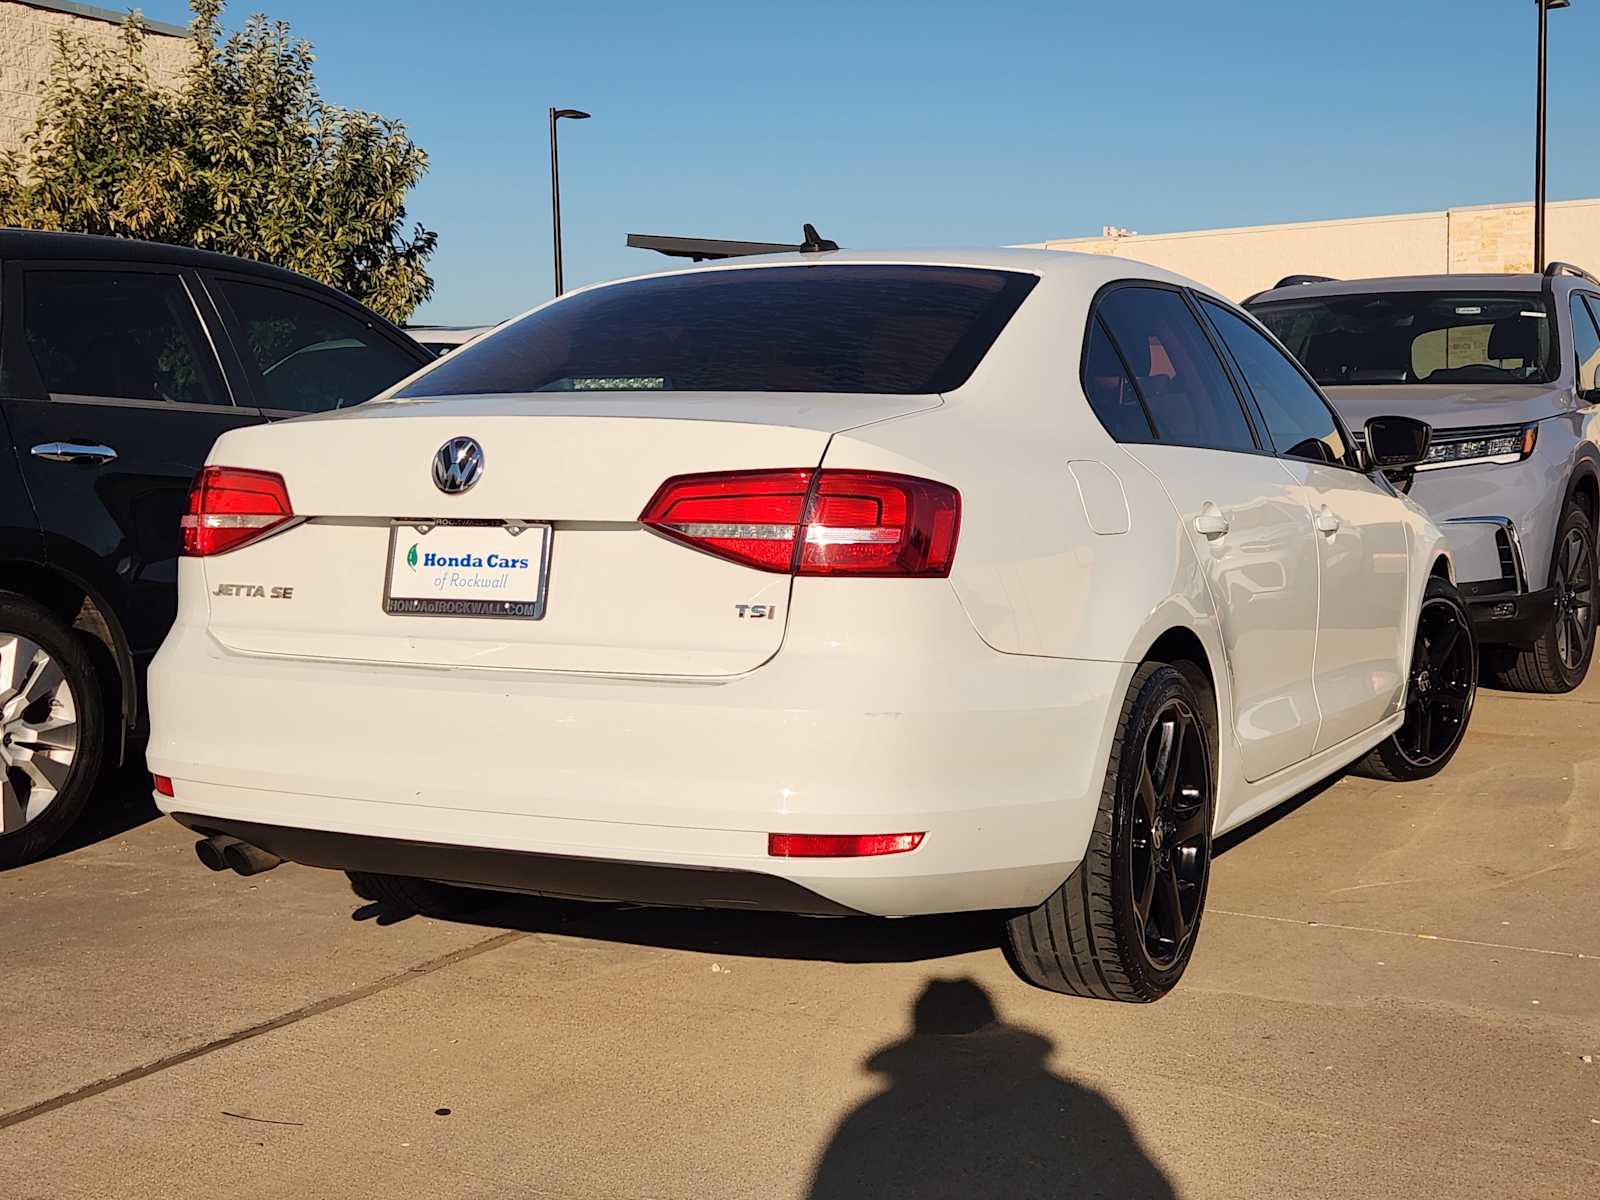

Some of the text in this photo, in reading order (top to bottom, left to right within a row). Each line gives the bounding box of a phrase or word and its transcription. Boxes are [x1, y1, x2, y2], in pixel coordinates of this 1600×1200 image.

[424, 553, 529, 569] Honda Cars
[433, 572, 508, 591] of Rockwall
[212, 583, 294, 599] JETTA SE
